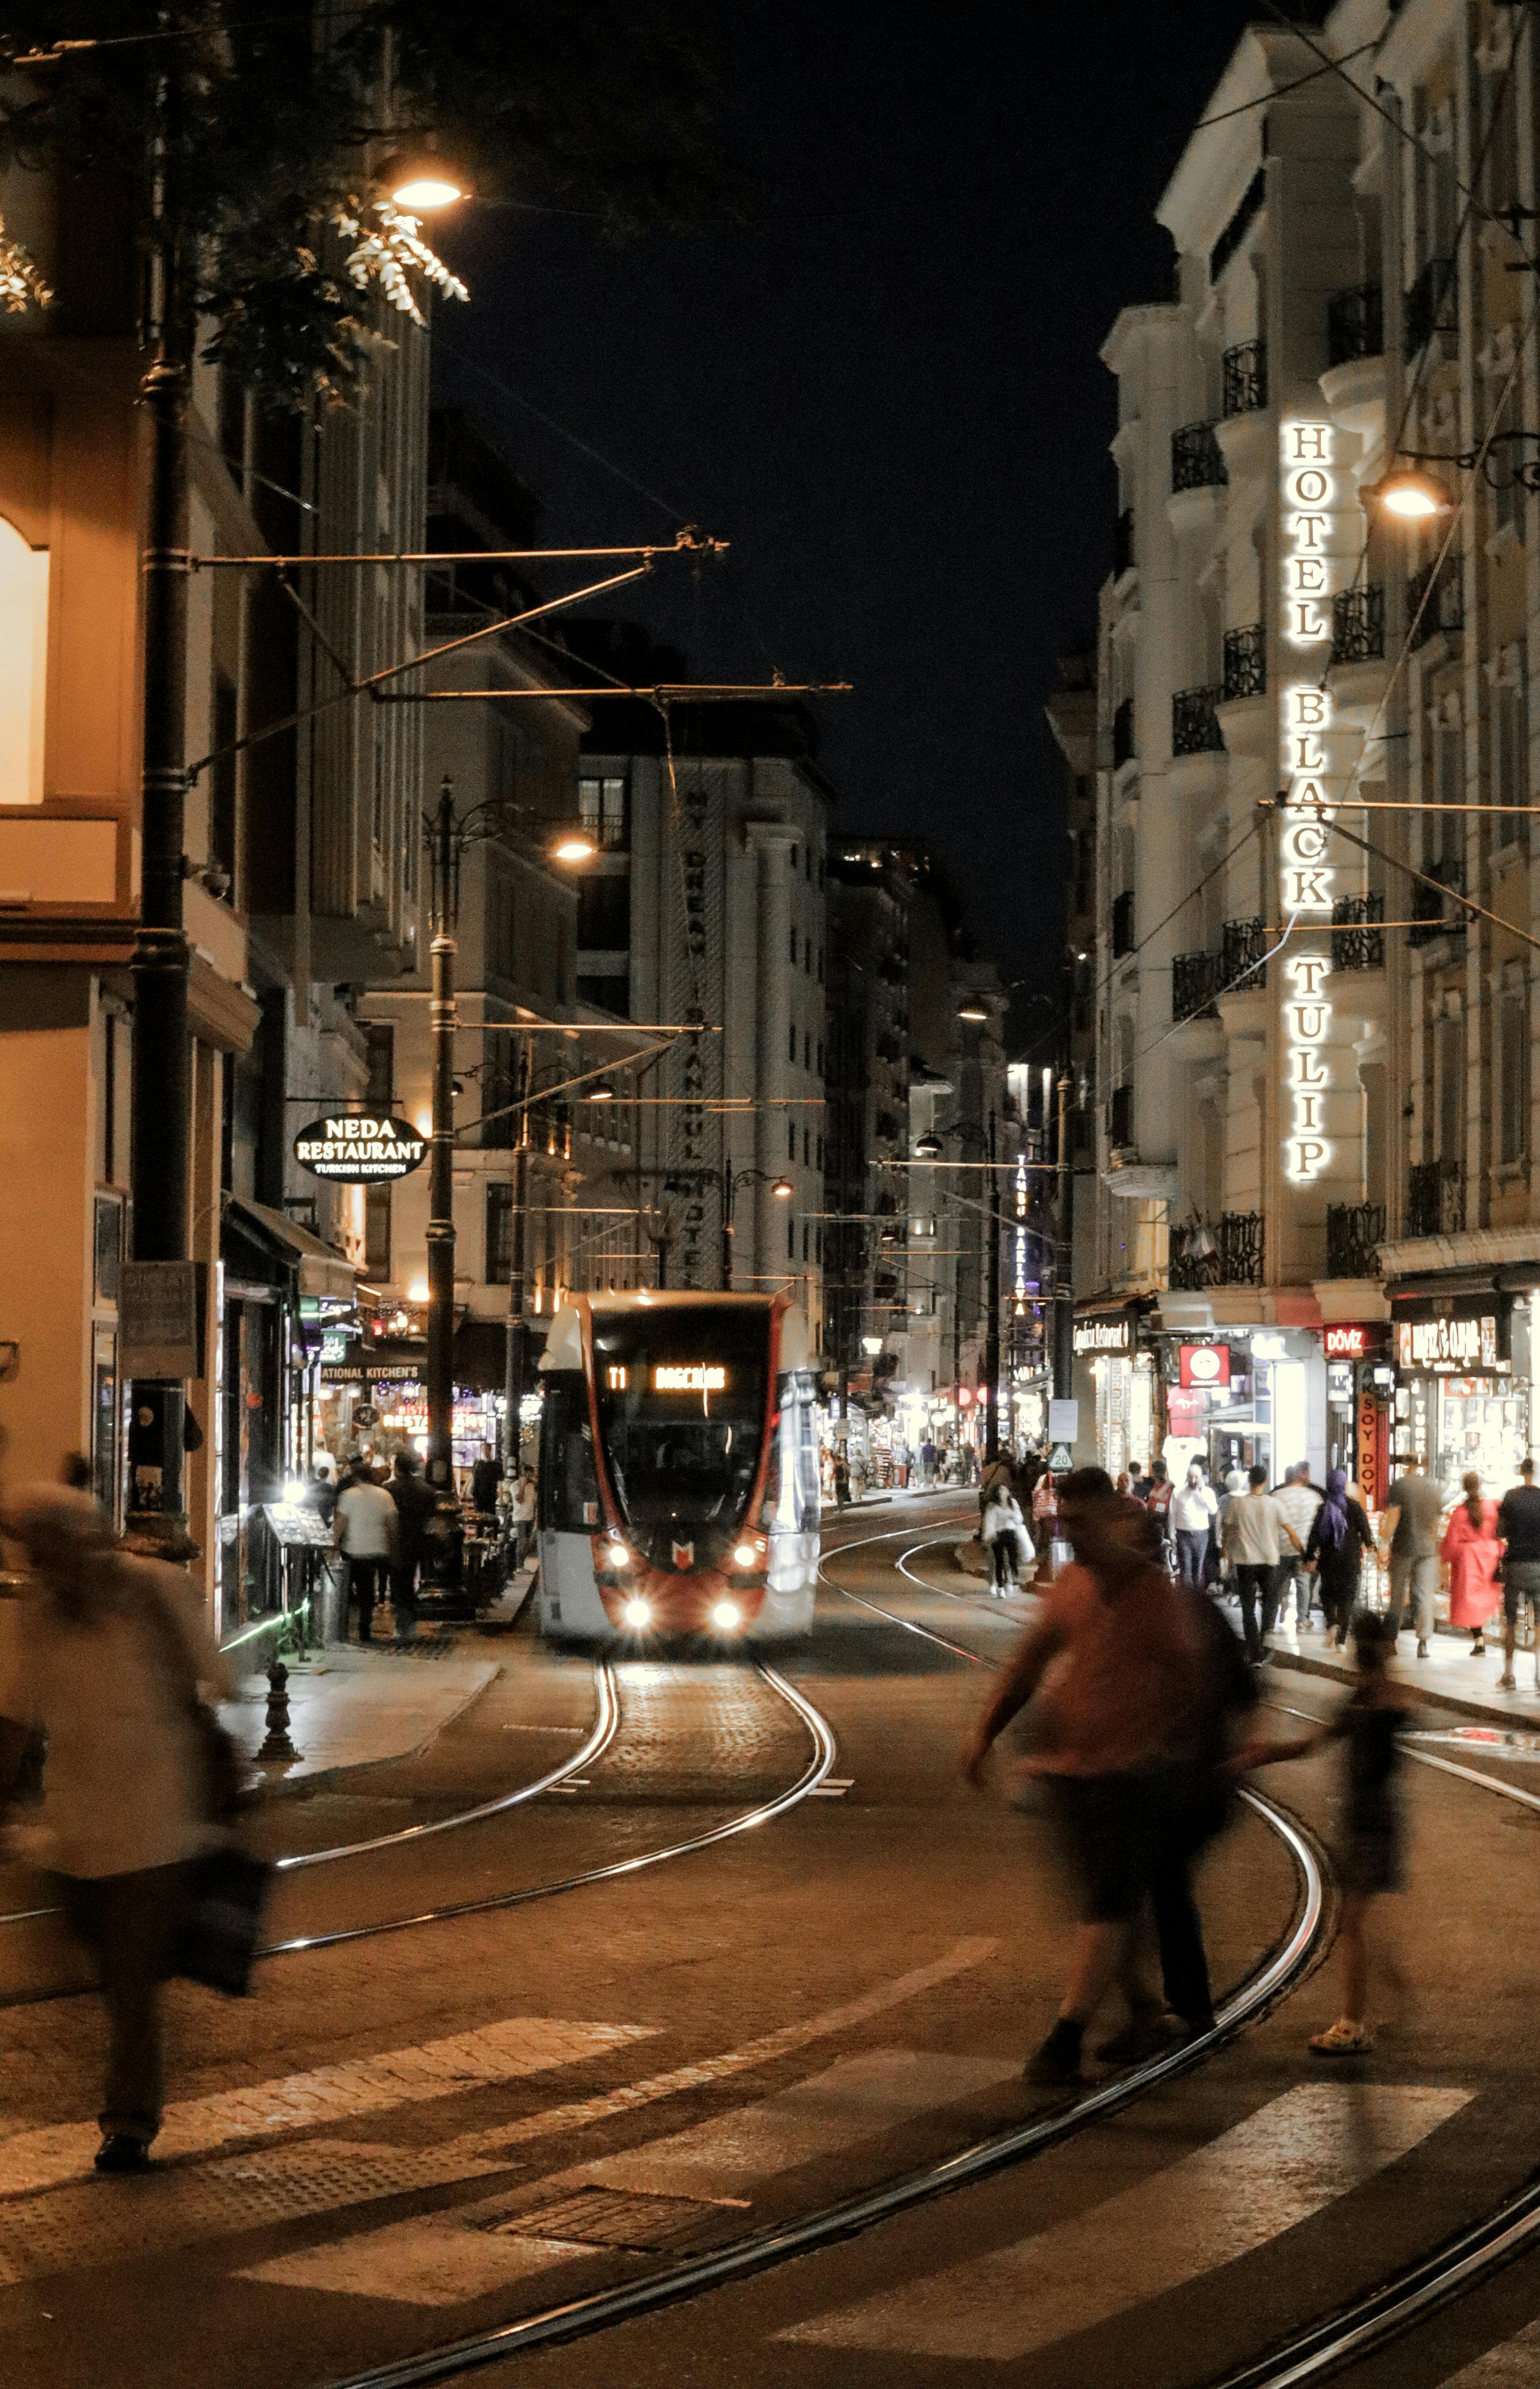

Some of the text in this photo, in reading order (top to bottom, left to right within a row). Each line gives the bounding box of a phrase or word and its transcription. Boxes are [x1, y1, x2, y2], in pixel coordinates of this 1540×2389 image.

[1293, 427, 1327, 1173] HOTEL BLACK TULIP
[326, 1119, 396, 1138] NEDA
[297, 1141, 424, 1159] RESTAURANT
[315, 1164, 406, 1174] TURKISH KITCHEN
[1327, 1329, 1362, 1350] DÖVİZ
[366, 1366, 418, 1378] KITCHEN'S
[610, 1367, 625, 1389] T1
[1055, 1455, 1067, 1465] 20
